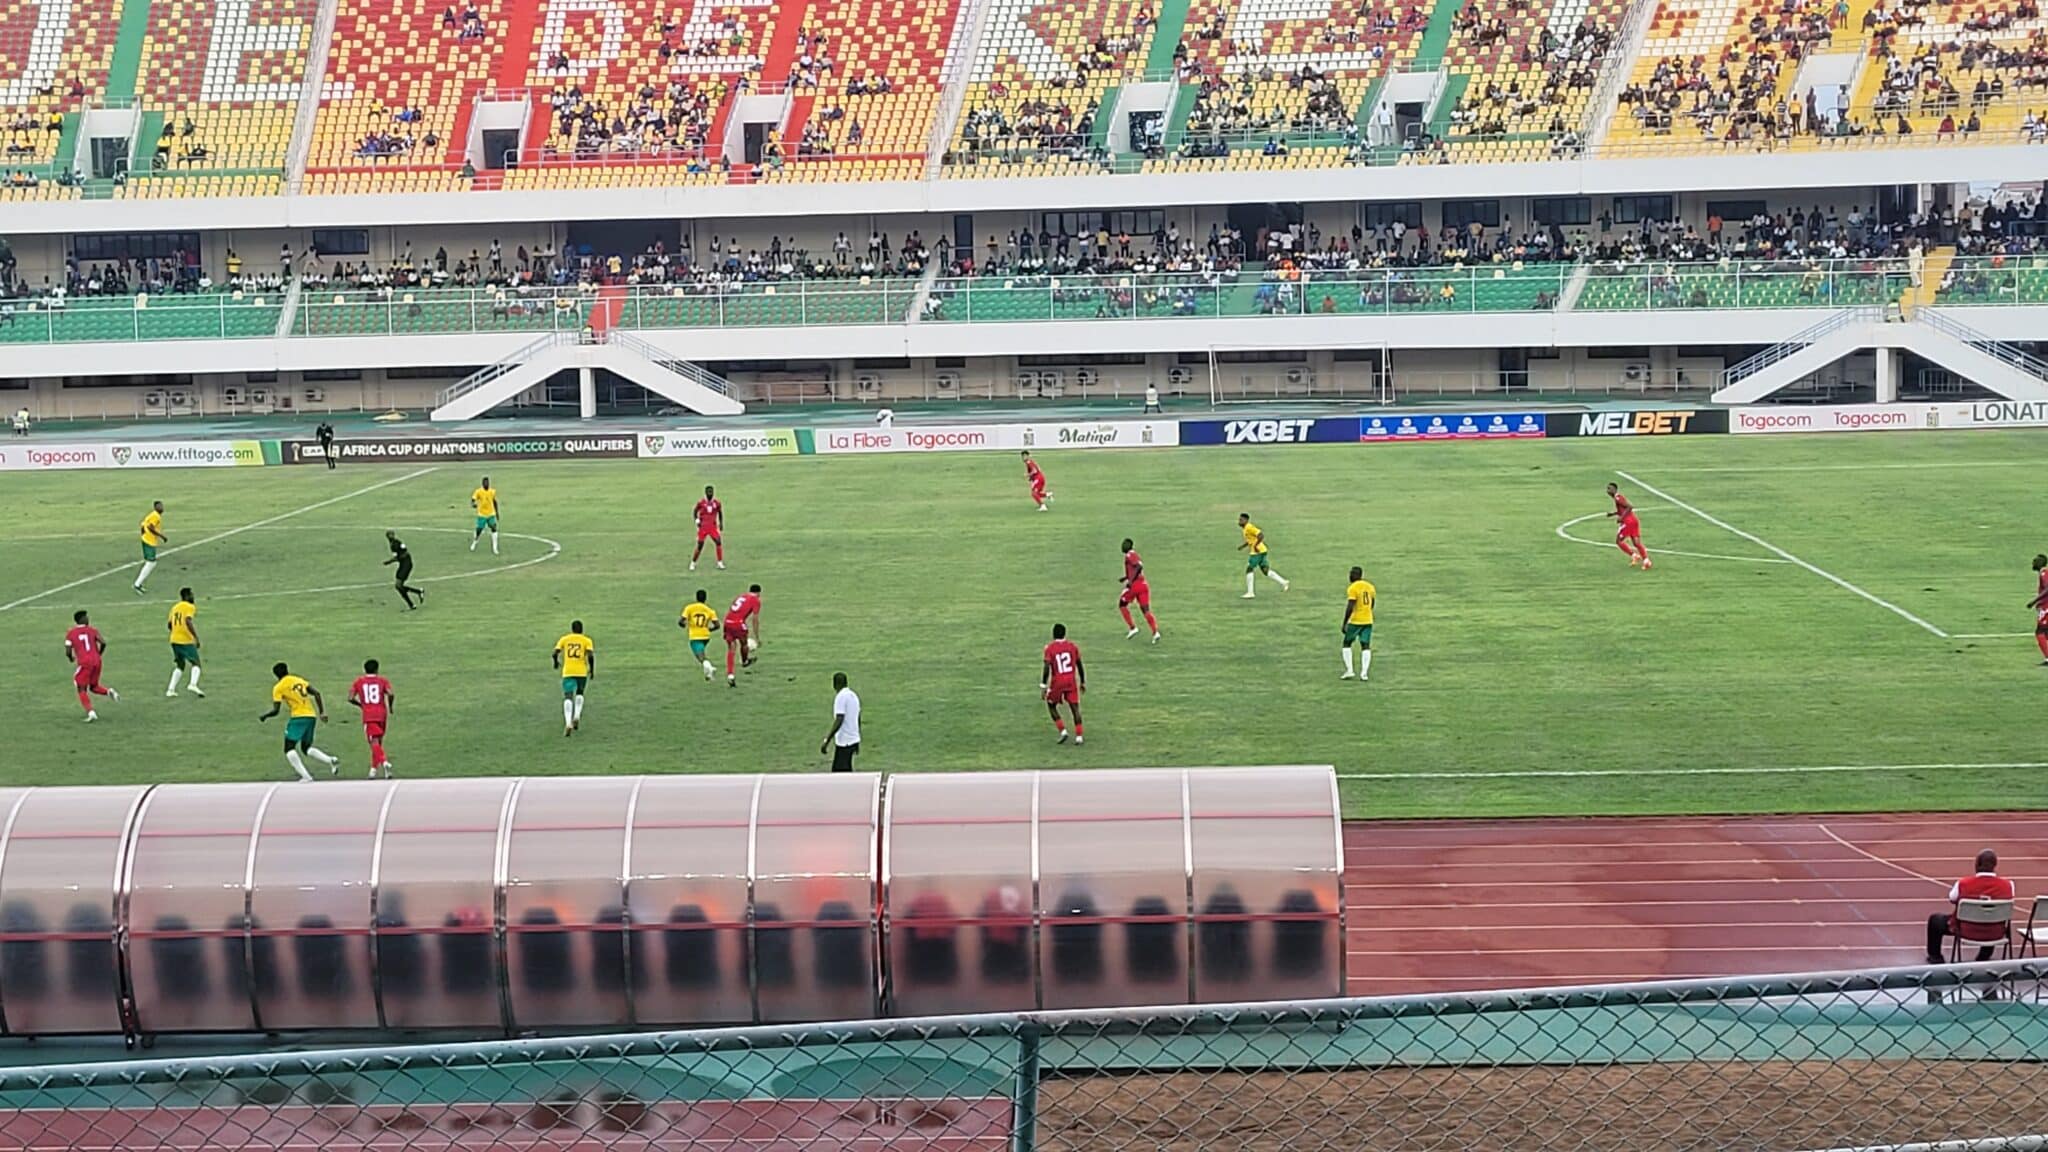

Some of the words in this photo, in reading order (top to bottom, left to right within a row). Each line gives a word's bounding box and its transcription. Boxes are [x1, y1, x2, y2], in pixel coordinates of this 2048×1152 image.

[1579, 411, 1695, 435] MELBET
[1739, 414, 1812, 429] Togocom
[1833, 412, 1907, 427] Togocom
[1058, 428, 1118, 444] Matinal
[1224, 419, 1315, 443] 1XBET
[342, 444, 384, 456] AFRICA
[387, 443, 413, 455] CUP
[415, 444, 431, 455] OF
[432, 442, 485, 455] NATIONS
[487, 441, 548, 453] MOROCCO
[549, 441, 562, 451] 25
[564, 440, 633, 454] QUALIFIERS
[671, 436, 788, 450] www.ftftogo.com
[829, 434, 849, 449] La
[853, 433, 892, 448] Fibre
[906, 431, 985, 449] Togocom
[27, 450, 96, 466] Togocom
[138, 448, 254, 462] www.ftftogo.com
[731, 596, 746, 612] 5
[78, 634, 91, 651] 7
[567, 643, 581, 659] 22
[1055, 651, 1073, 674] 12
[362, 683, 380, 704] 18
